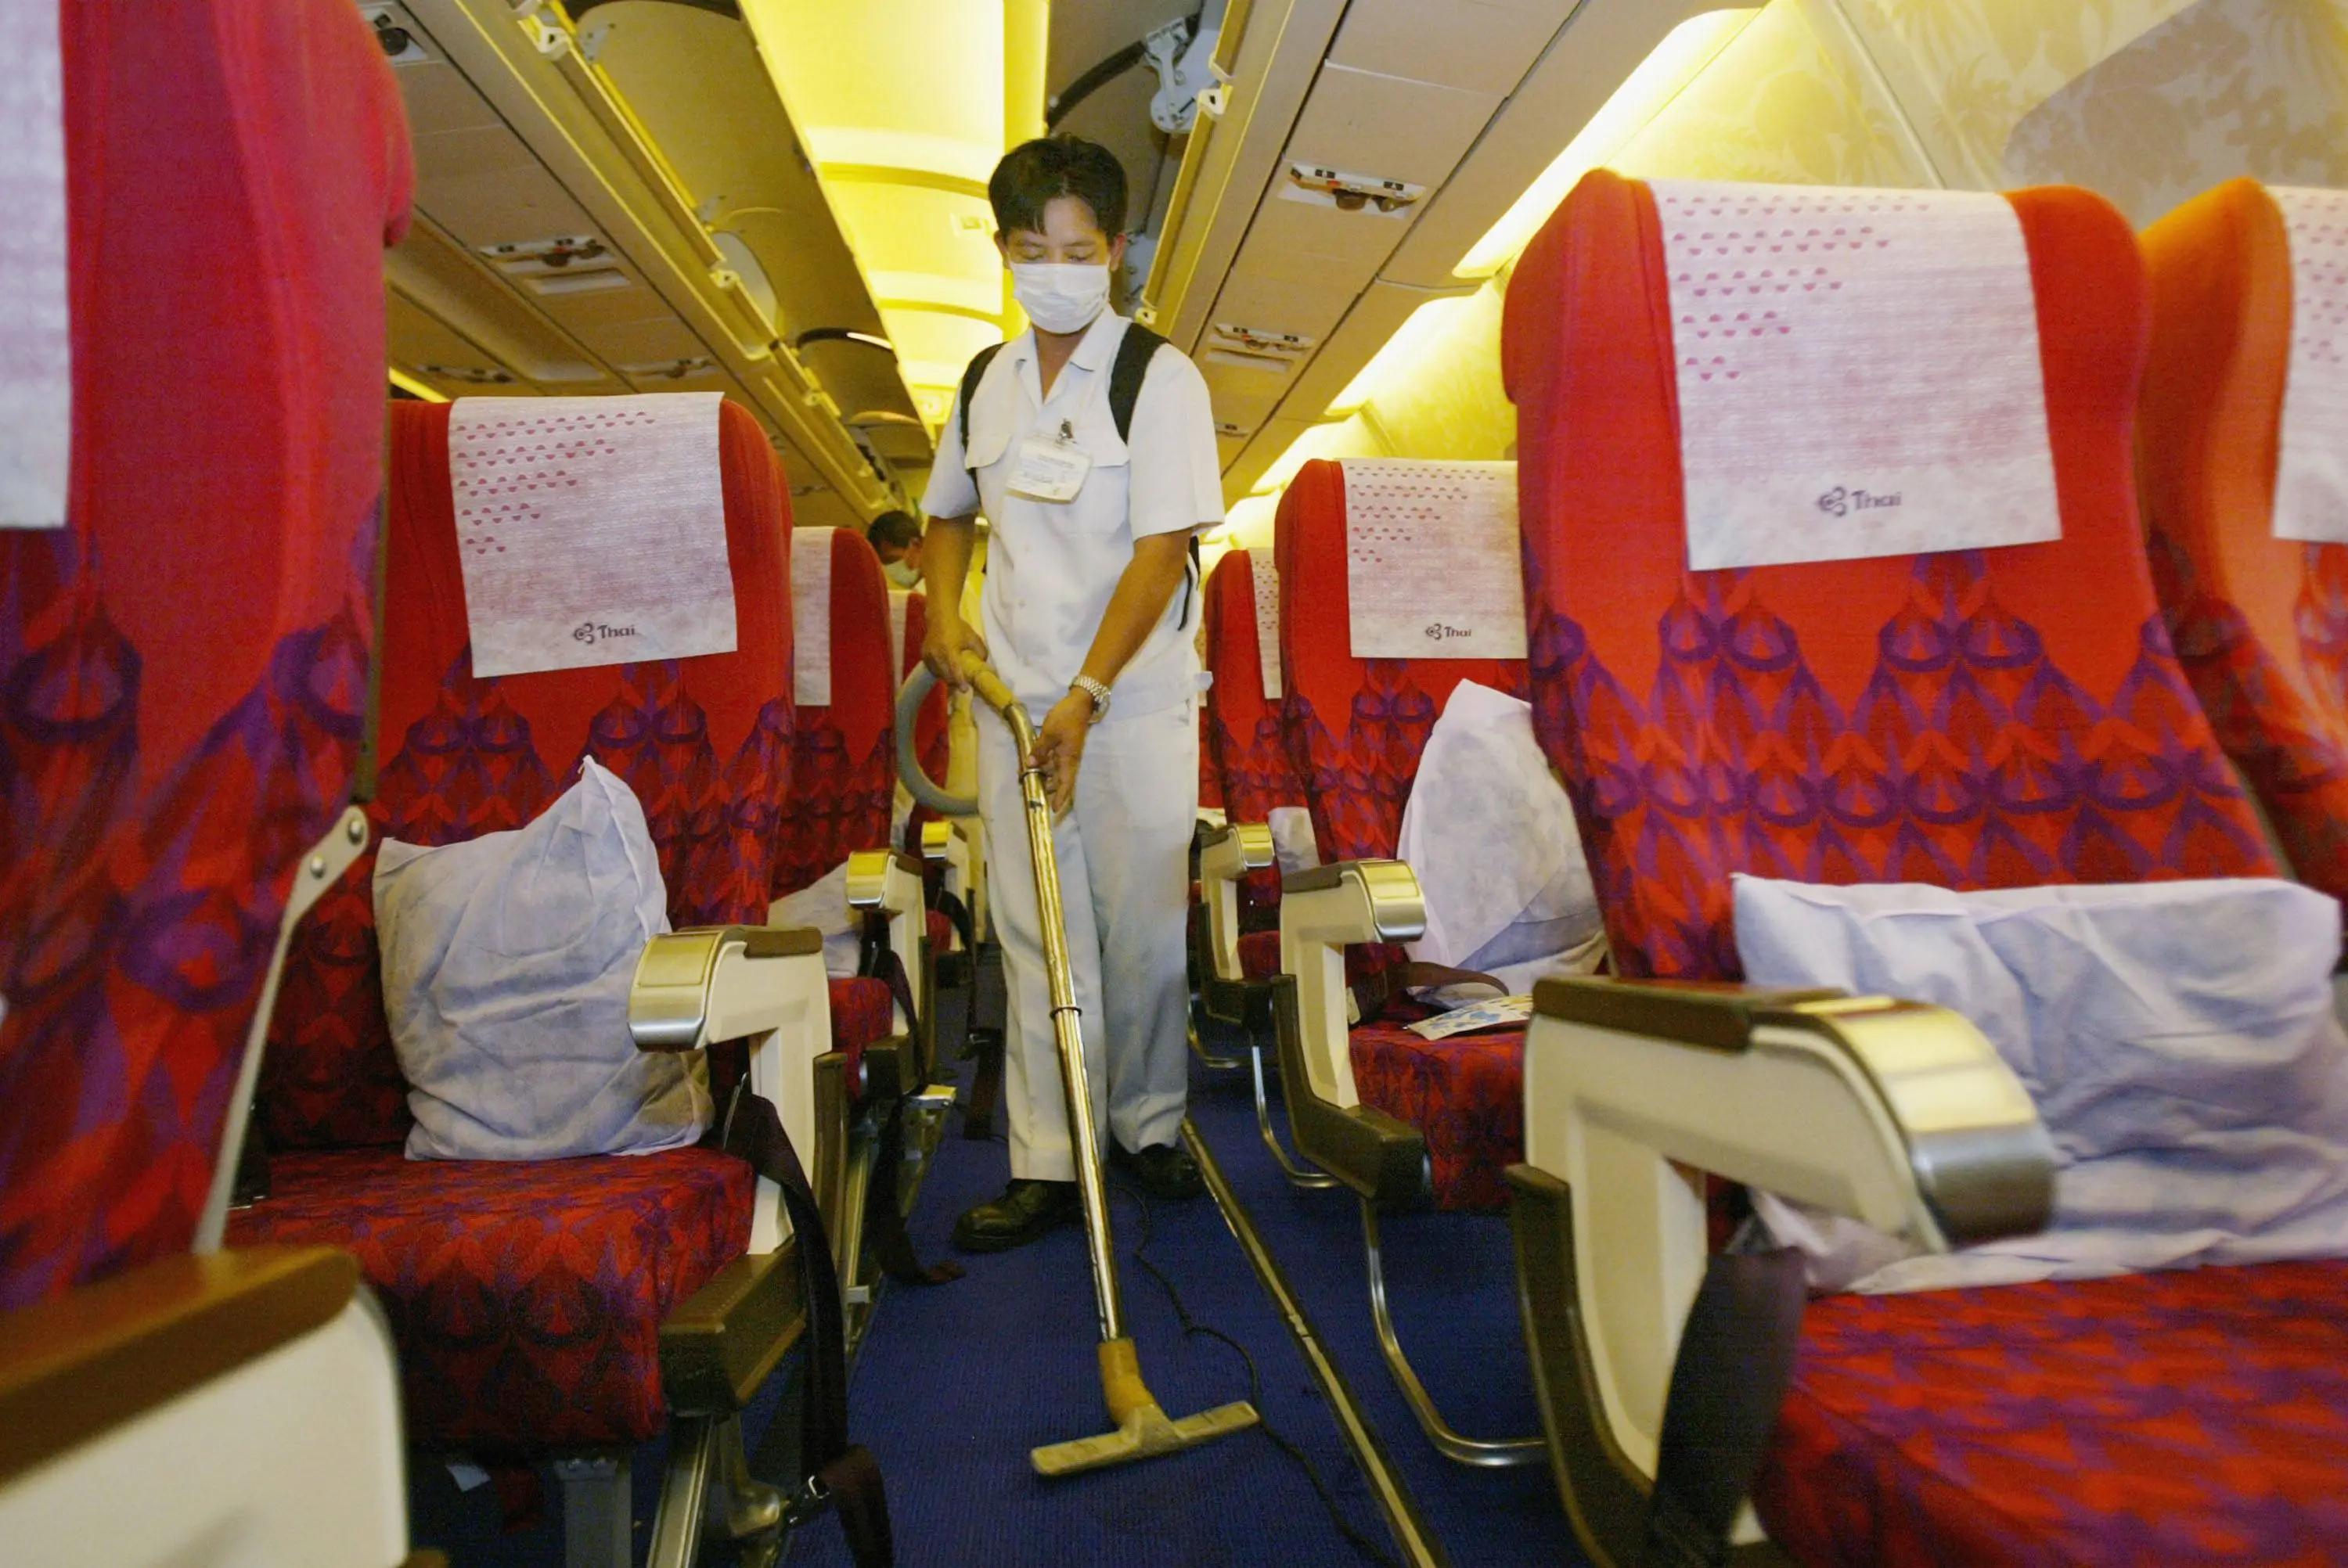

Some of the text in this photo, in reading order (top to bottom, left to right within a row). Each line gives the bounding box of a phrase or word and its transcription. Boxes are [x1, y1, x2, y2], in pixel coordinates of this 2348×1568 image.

[1851, 490, 1902, 510] Thai
[597, 625, 635, 638] Thai
[1444, 626, 1471, 638] Thai
